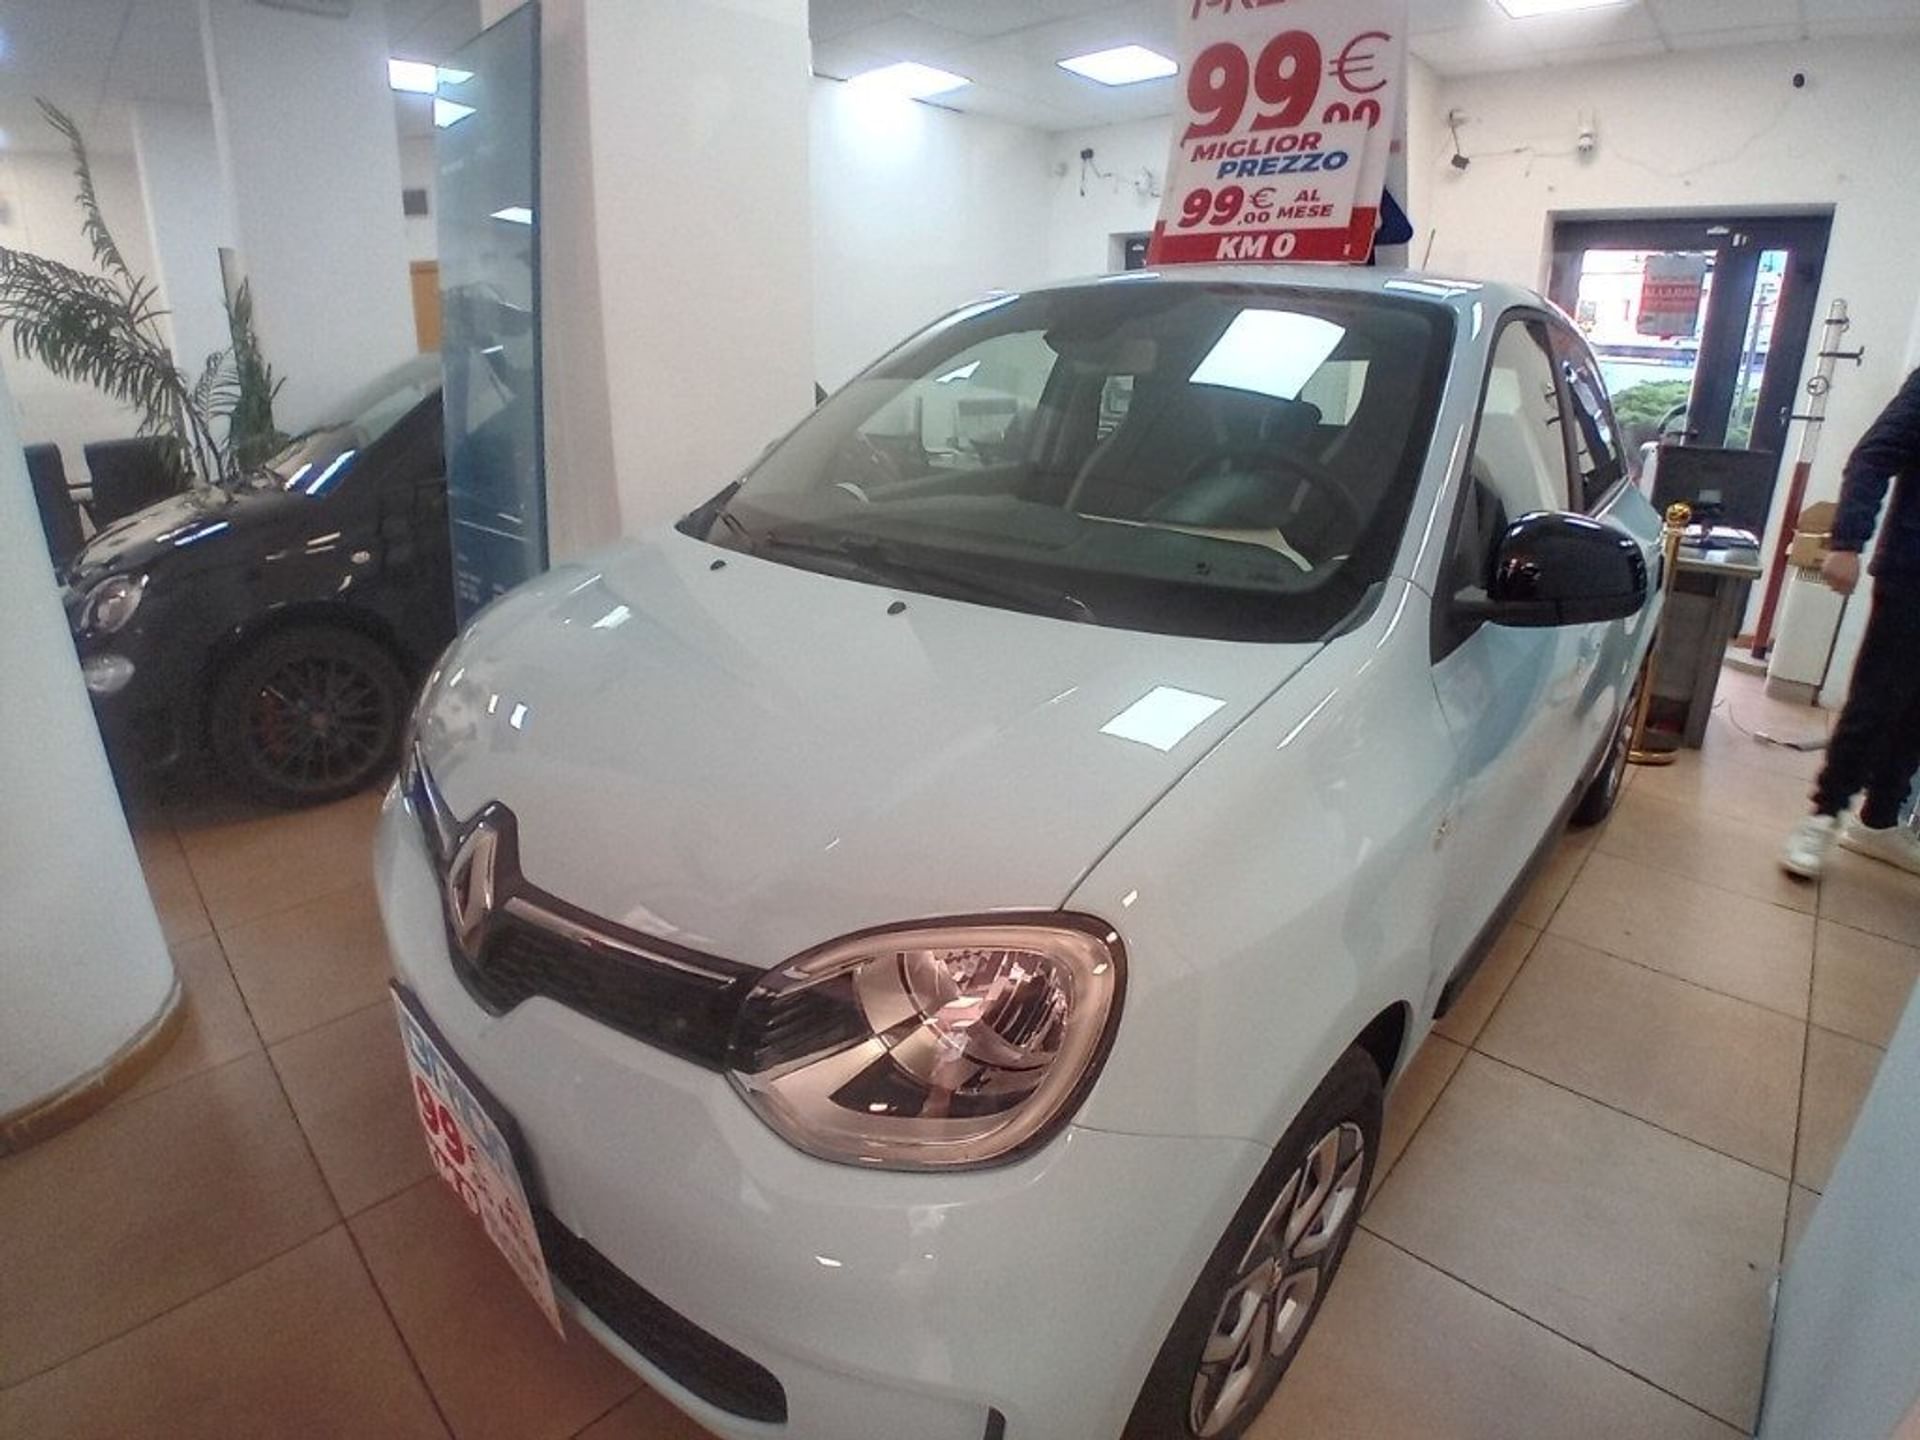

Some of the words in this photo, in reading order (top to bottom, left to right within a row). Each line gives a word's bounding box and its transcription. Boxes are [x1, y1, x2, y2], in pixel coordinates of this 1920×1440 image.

[1181, 30, 1322, 147] 99
[1328, 31, 1392, 94] €
[1190, 131, 1322, 162] MIGLIOR
[1216, 151, 1348, 179] PREZZO
[1178, 185, 1244, 228] 99
[1250, 187, 1276, 209] €
[1294, 189, 1320, 202] AL
[1276, 204, 1334, 219] MESE
[1216, 234, 1268, 260] KM
